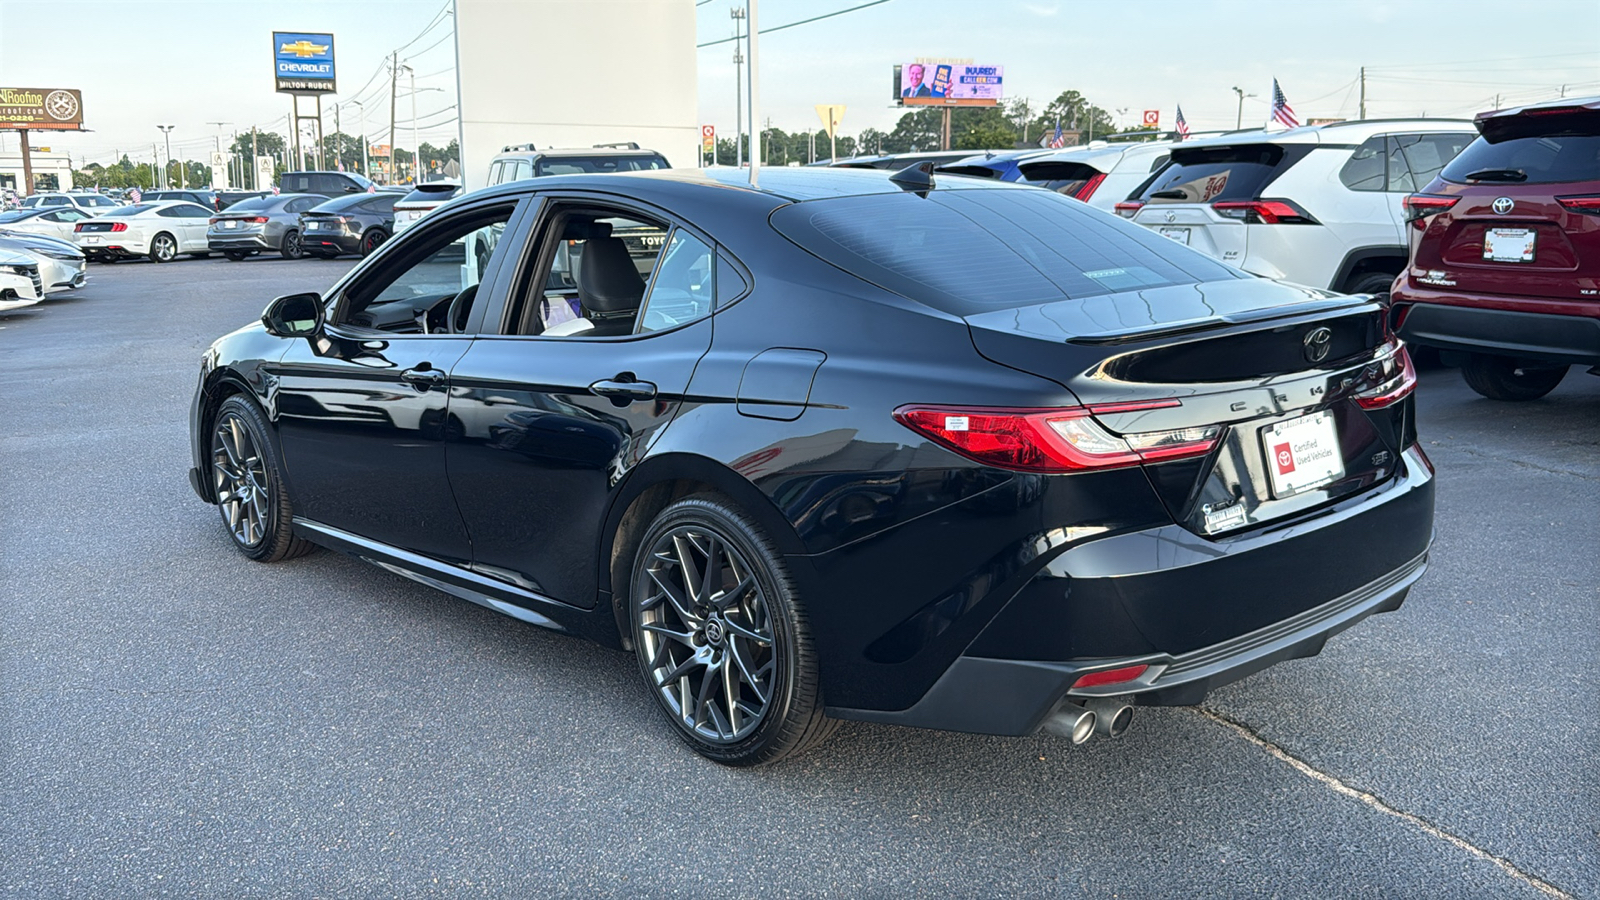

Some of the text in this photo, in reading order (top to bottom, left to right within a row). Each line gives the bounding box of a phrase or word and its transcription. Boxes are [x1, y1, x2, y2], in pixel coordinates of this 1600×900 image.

[280, 63, 330, 72] CHEVROLET
[8, 91, 43, 106] Roofing
[640, 236, 678, 246] TOYOA
[1294, 439, 1318, 453] Certified
[1296, 449, 1333, 465] Used Vehicles
